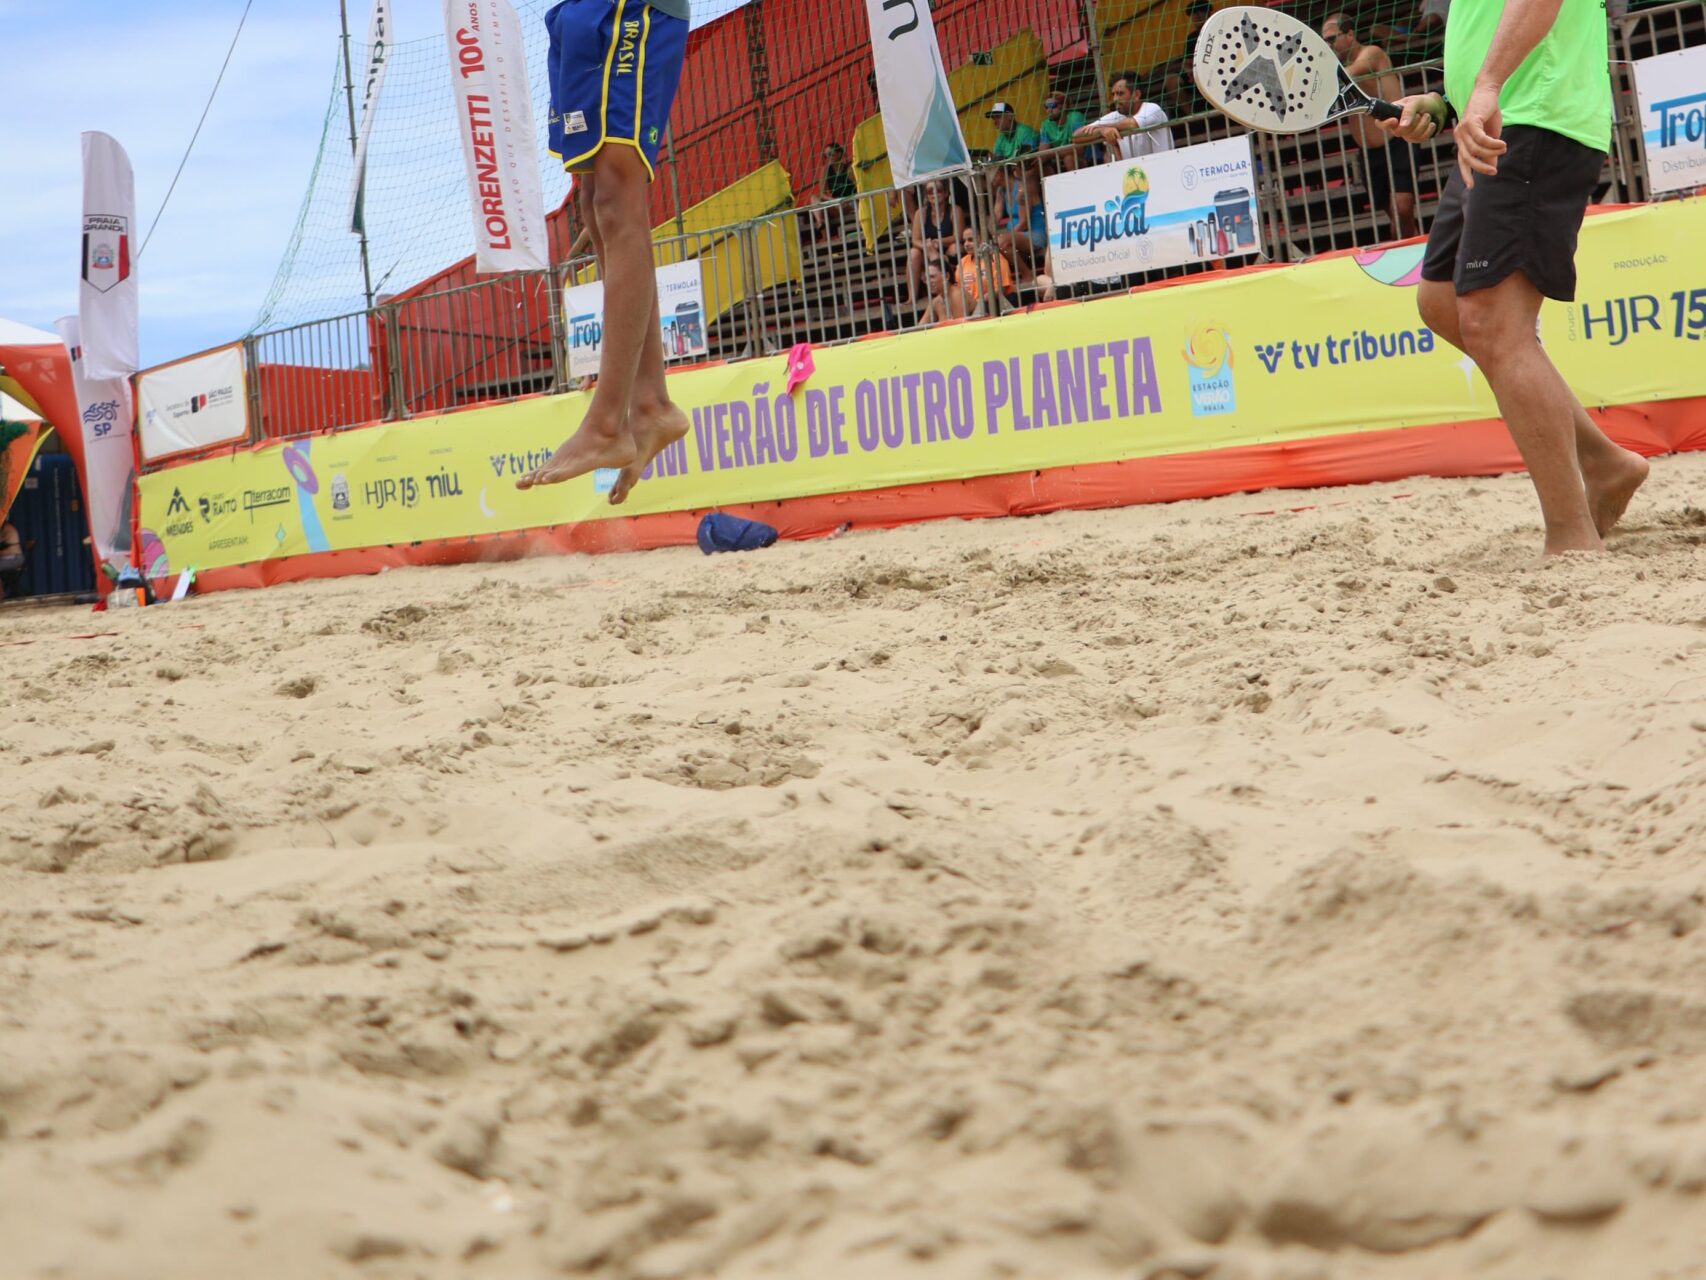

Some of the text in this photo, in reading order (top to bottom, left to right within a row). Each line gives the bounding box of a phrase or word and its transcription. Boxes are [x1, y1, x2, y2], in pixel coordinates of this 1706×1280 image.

[489, 1, 502, 46] TEMPO
[616, 20, 640, 77] BRASIL
[498, 72, 512, 133] DESAFIA
[455, 2, 512, 250] LORENZETTI 100 ANOS
[1650, 92, 1706, 149] Tro
[506, 143, 518, 168] QUE
[1199, 160, 1248, 178] TERMOLAR
[83, 224, 125, 233] GRANDE
[88, 217, 121, 225] PRAIA
[1055, 196, 1150, 252] Tropical
[1060, 249, 1132, 271] Distribuidora Oficial
[1466, 259, 1489, 270] mitre
[666, 279, 698, 293] TERMOLAR
[1582, 294, 1662, 346] HJR
[1669, 288, 1706, 339] 15
[1291, 327, 1434, 370] tv tribuna
[692, 381, 799, 472] VERÃO
[805, 384, 849, 459] DE
[854, 364, 975, 452] OUTRO
[983, 336, 1162, 435] PLANETA
[94, 422, 112, 437] SP
[509, 452, 525, 475] tv
[365, 479, 398, 509] HJR
[426, 465, 463, 498] niu
[213, 498, 237, 516] RAITO
[251, 486, 291, 504] terracom
[165, 521, 194, 537] MENDES
